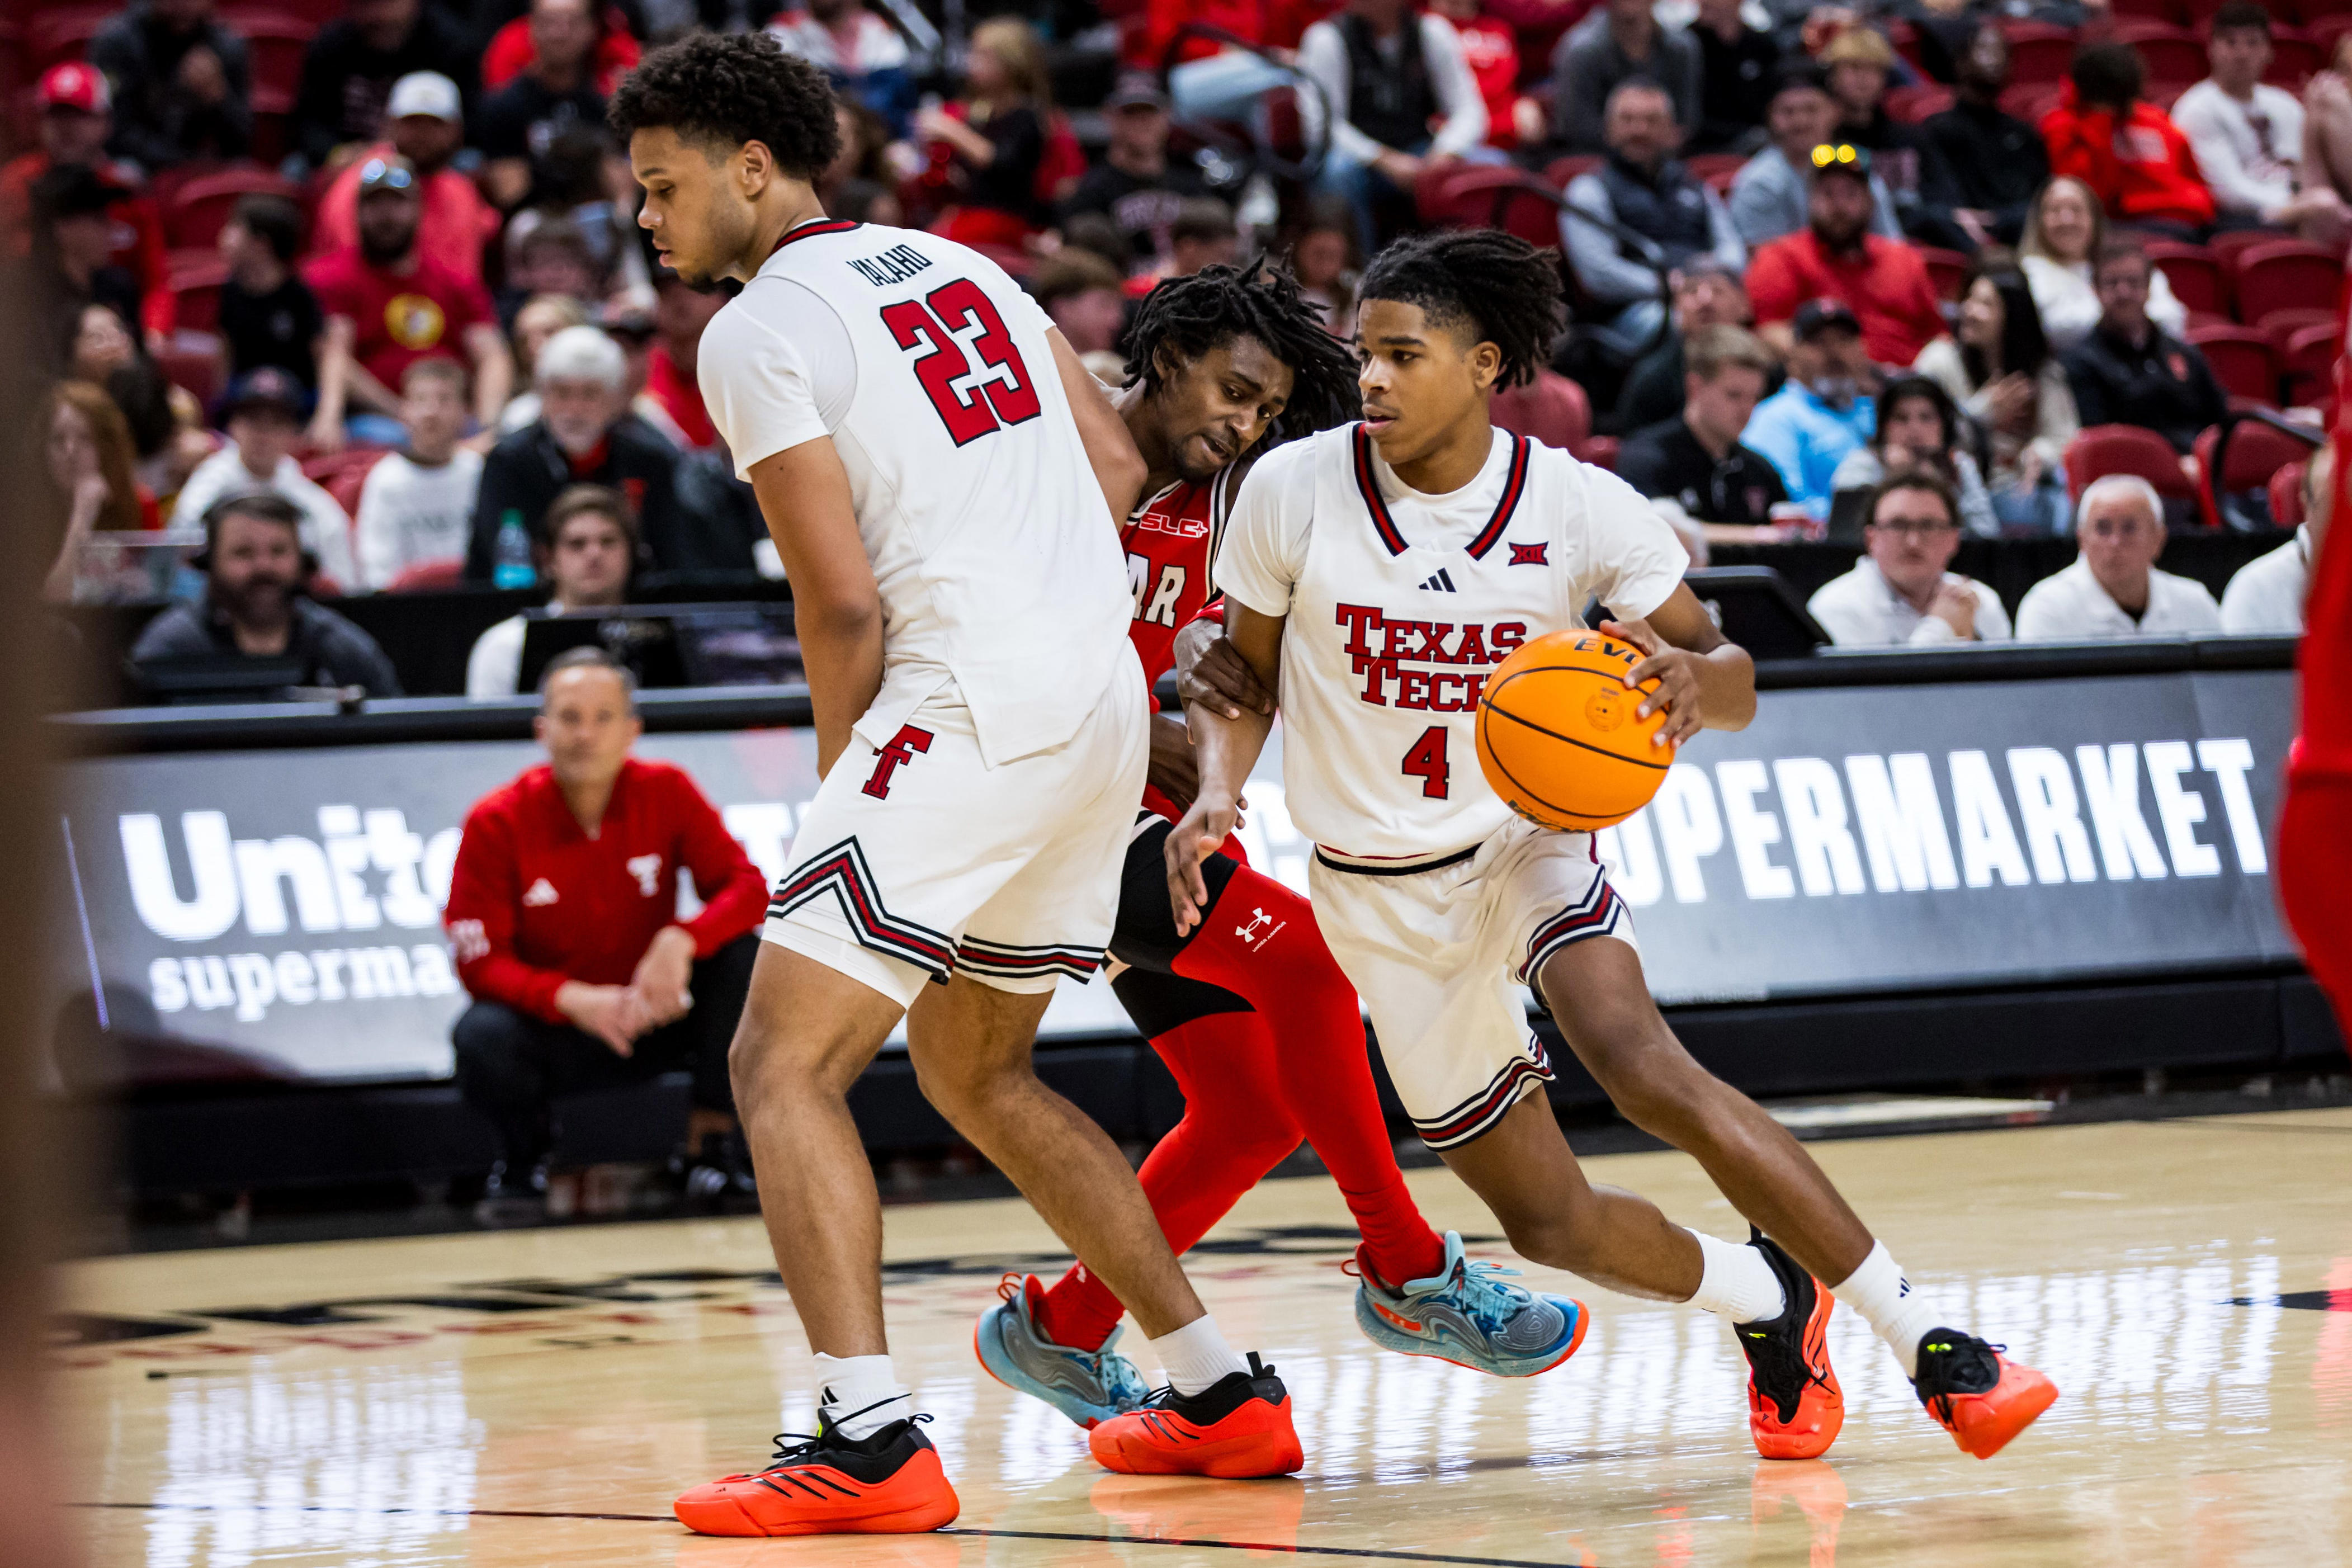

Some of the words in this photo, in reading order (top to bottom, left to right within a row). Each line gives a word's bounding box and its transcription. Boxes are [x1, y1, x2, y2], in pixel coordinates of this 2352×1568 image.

[846, 244, 933, 287] YALAHO
[880, 277, 1042, 448] 23
[1139, 512, 1209, 539] SLC
[1127, 551, 1186, 629] AR
[1335, 602, 1527, 665] TEXAS
[1401, 726, 1449, 800] 4
[1599, 738, 2269, 908] UPERMARKET
[149, 944, 461, 1022] superma
